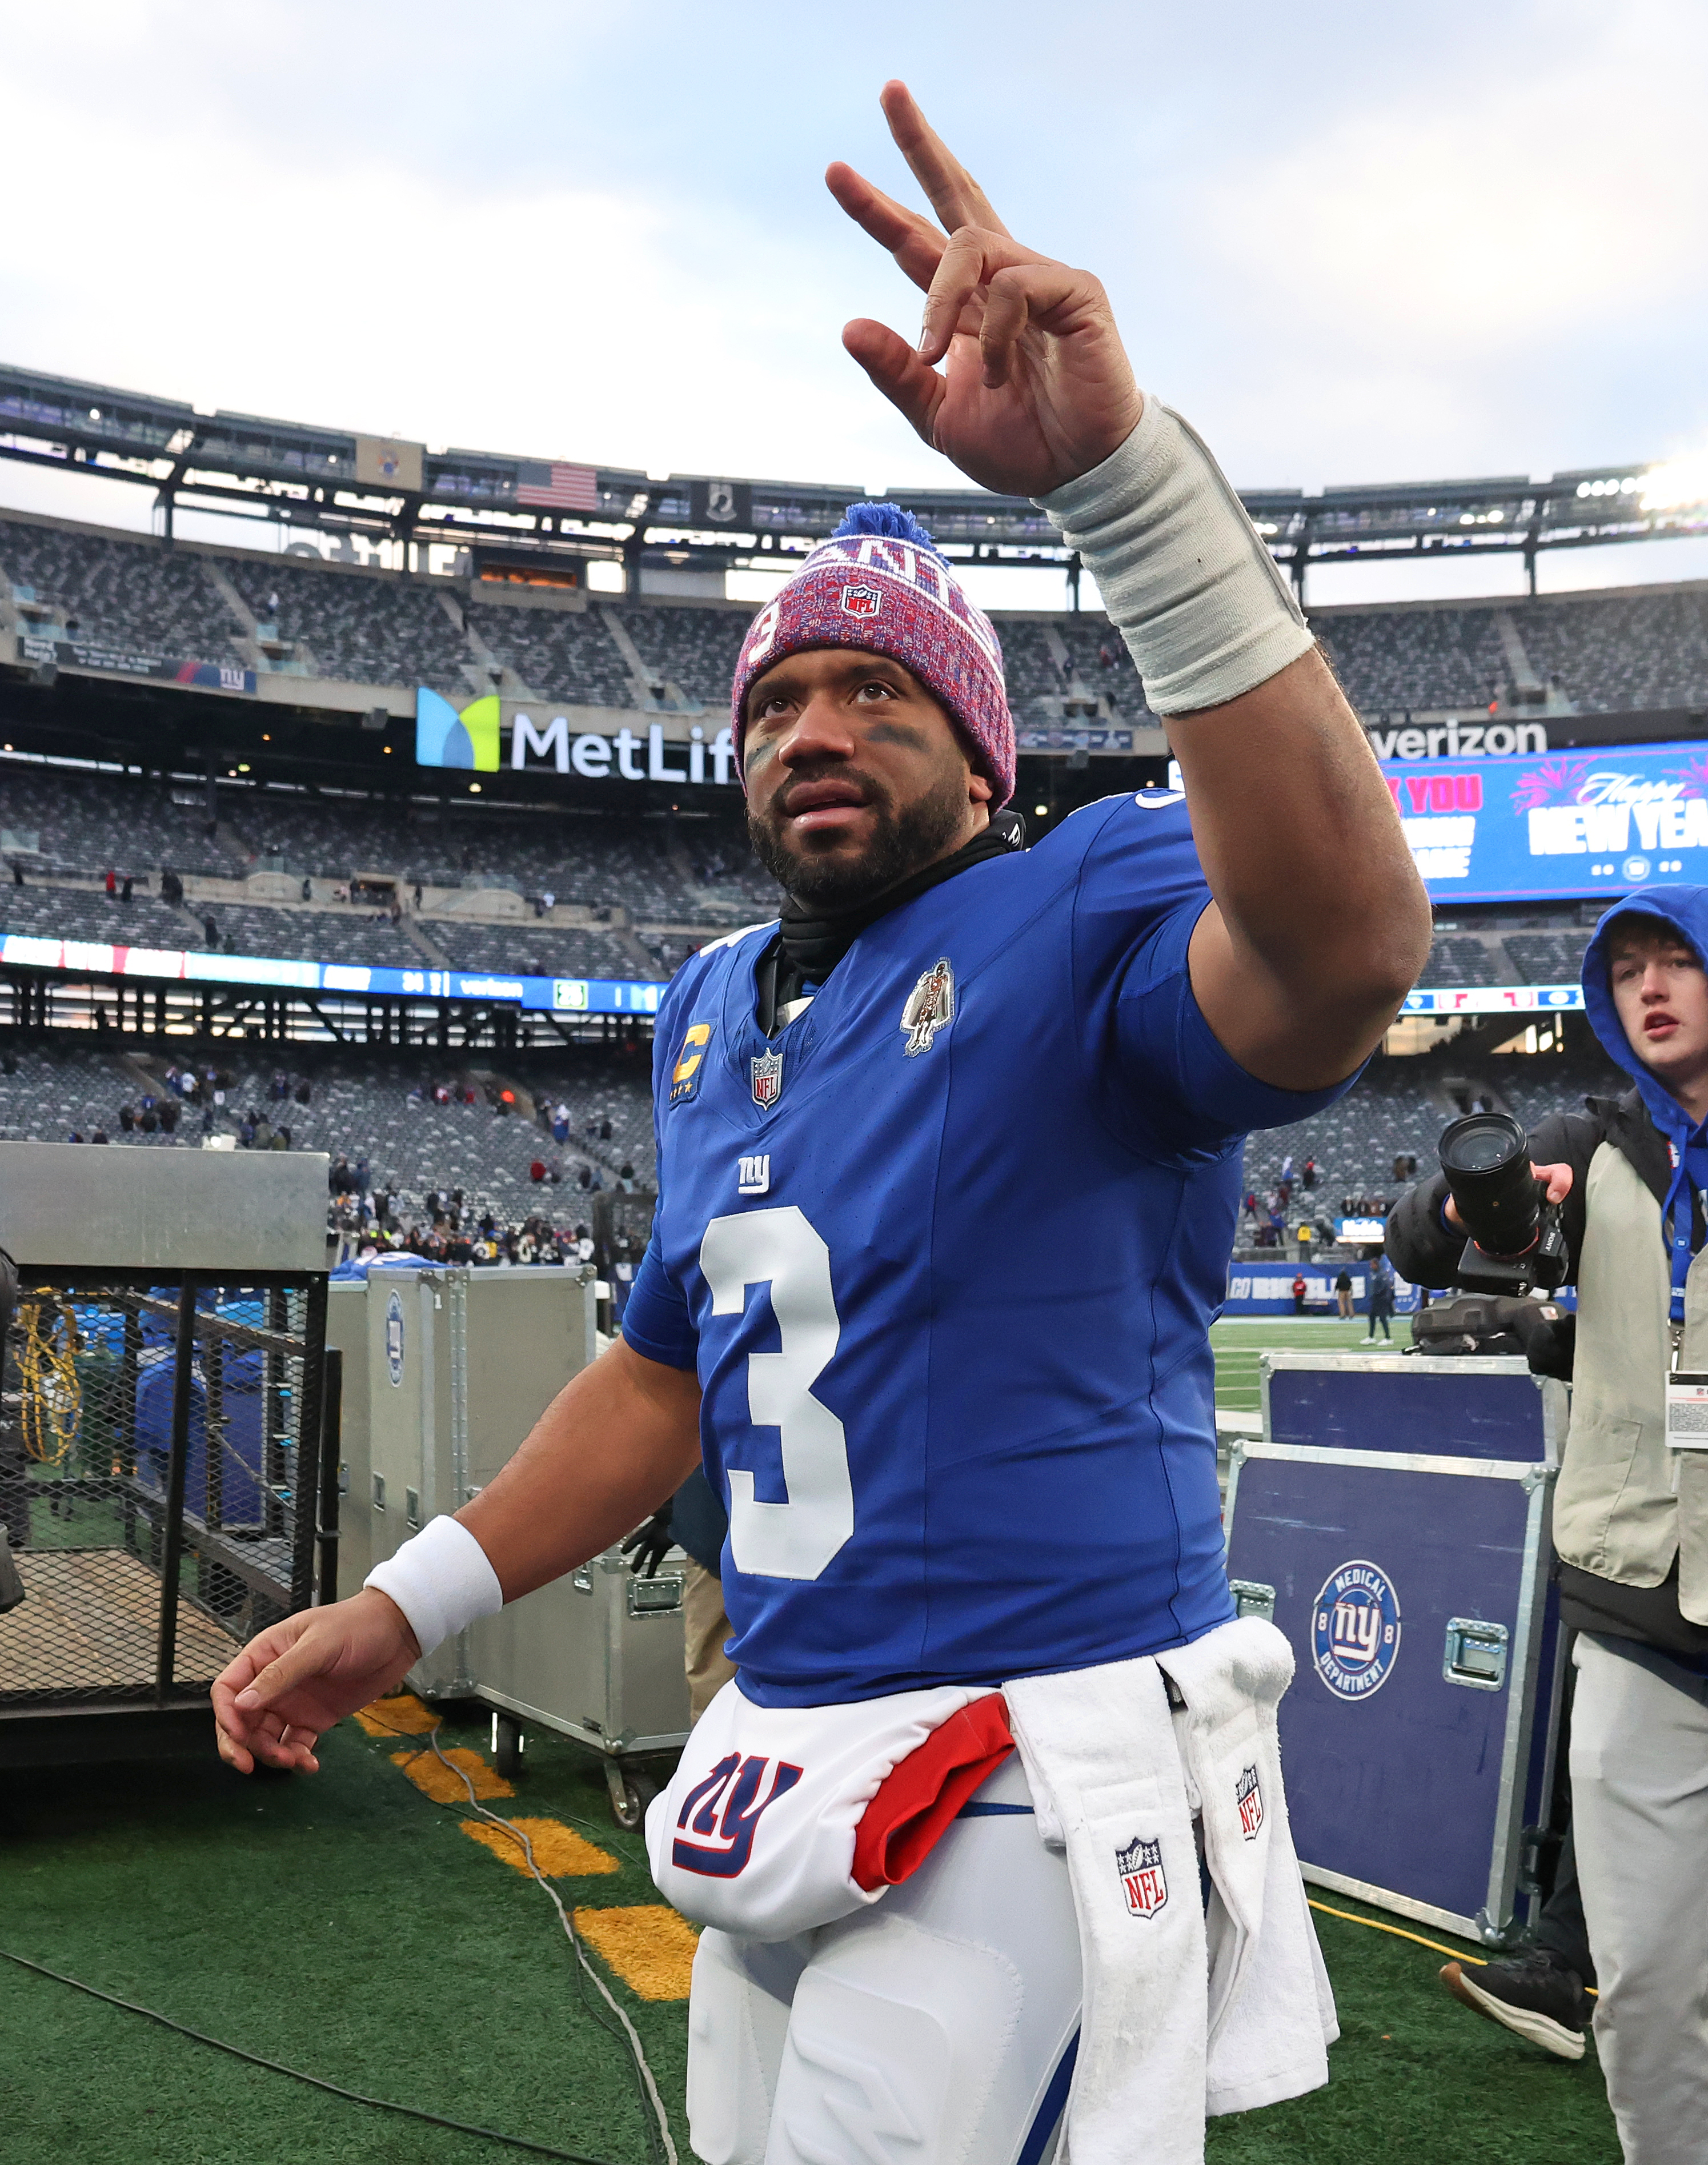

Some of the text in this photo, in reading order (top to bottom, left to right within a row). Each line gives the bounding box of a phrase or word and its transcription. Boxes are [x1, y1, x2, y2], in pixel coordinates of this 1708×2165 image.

[846, 597, 873, 614] NFL
[511, 713, 734, 784] MetLif
[1371, 719, 1548, 760] verizon
[1405, 773, 1483, 814] YOU
[1577, 772, 1687, 807] Happy
[1528, 802, 1632, 856] NEW
[1632, 798, 1708, 851] YEA
[673, 1024, 710, 1084] C
[756, 1076, 776, 1097] NFL
[1545, 1232, 1556, 1252] SONY
[434, 1294, 443, 1309] 1
[699, 1205, 854, 1581] 3
[1335, 1569, 1386, 1602] MEDICAL
[1318, 1612, 1328, 1631] 8
[1384, 1625, 1394, 1644] 8
[1321, 1651, 1384, 1693] DEPARTMENT
[1239, 1792, 1261, 1834] NFL
[1125, 1870, 1164, 1910] NFL
